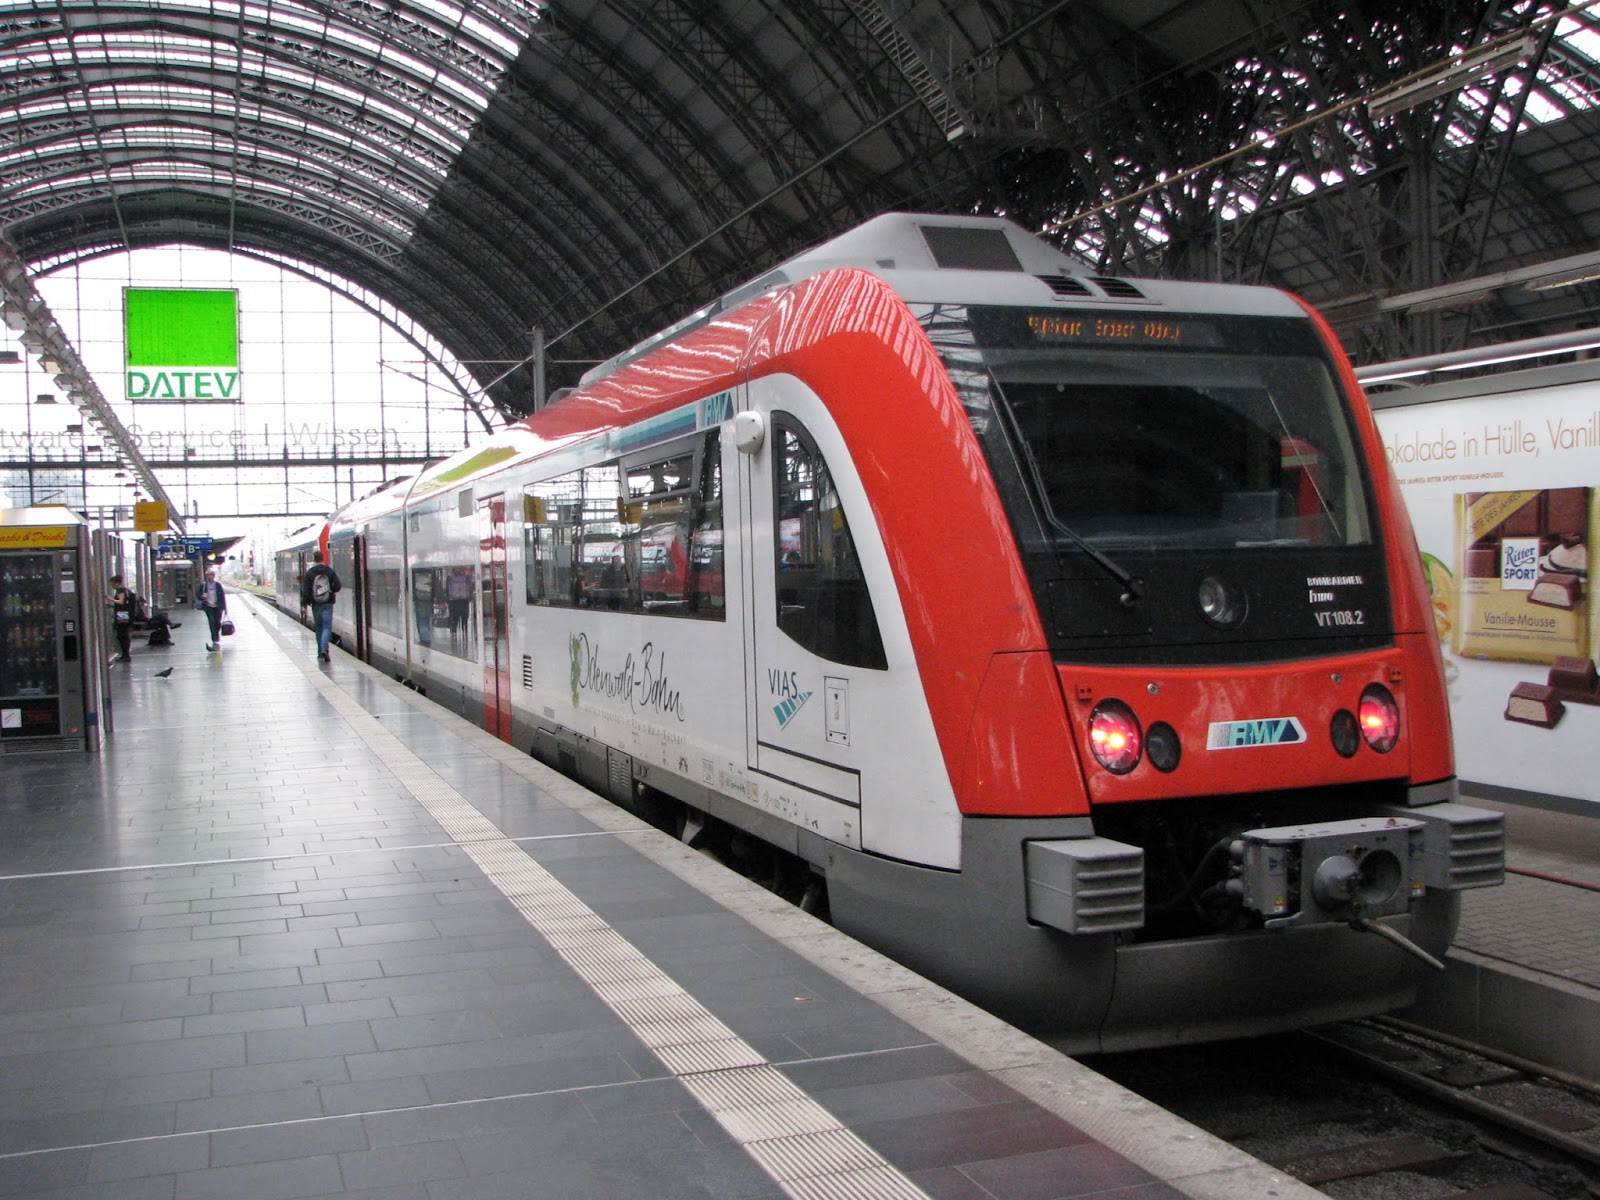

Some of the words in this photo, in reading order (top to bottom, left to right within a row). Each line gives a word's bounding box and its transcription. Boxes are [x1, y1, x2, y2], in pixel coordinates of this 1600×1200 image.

[128, 371, 238, 398] DATEV
[126, 424, 244, 449] Service
[289, 422, 401, 447] Wissen
[1463, 431, 1478, 457] in
[1484, 419, 1541, 458] Hülle,
[23, 532, 32, 541] &
[1504, 546, 1535, 567] Ritter
[1504, 568, 1536, 579] SPORT
[1483, 612, 1556, 629] Vanille-Mousse
[768, 668, 798, 700] VIAS
[1229, 719, 1300, 746] RMV
